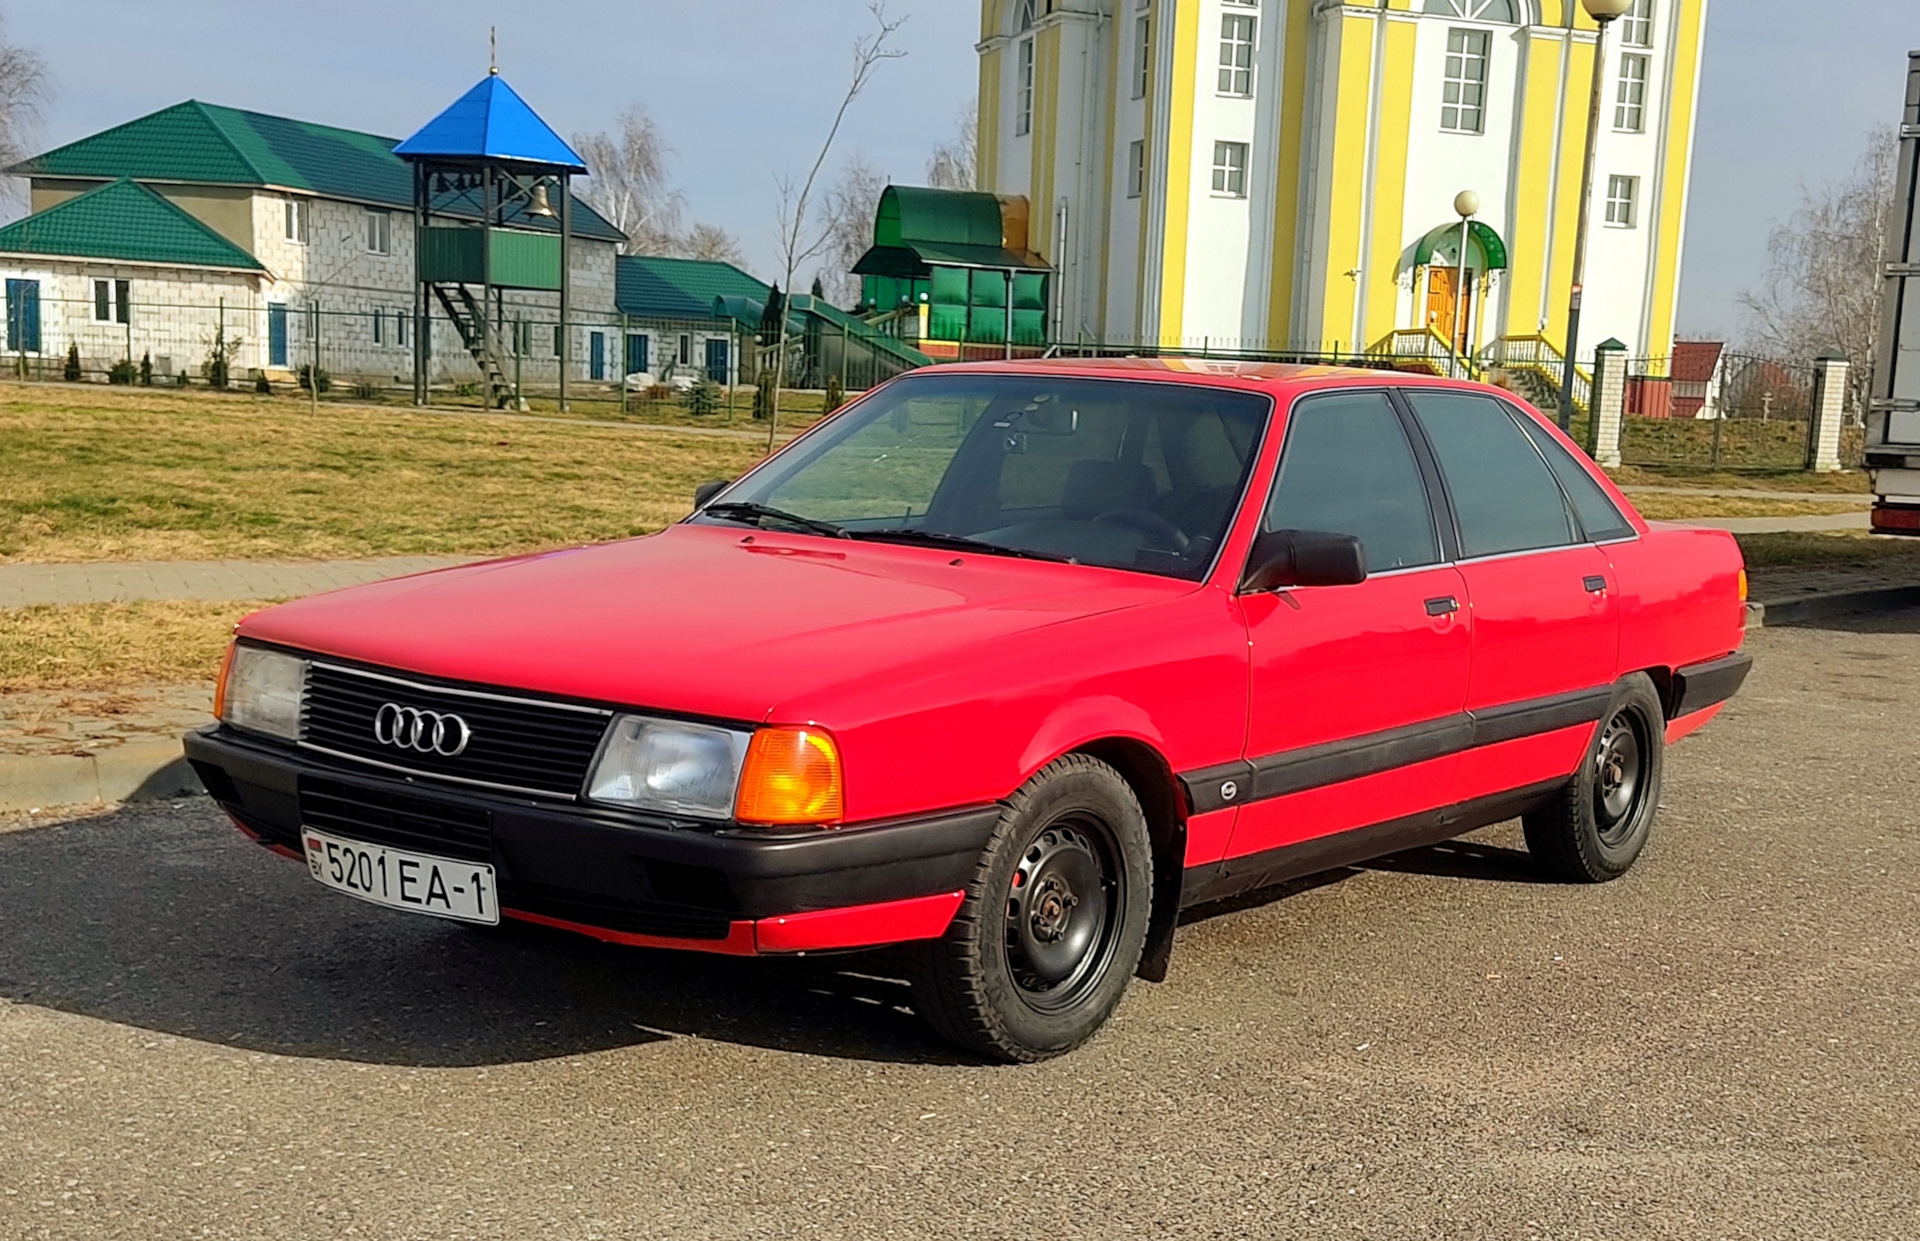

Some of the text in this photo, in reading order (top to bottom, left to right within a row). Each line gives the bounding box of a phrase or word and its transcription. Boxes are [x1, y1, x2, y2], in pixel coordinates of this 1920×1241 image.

[310, 859, 324, 878] BY
[326, 842, 484, 914] 5201 EA-1
